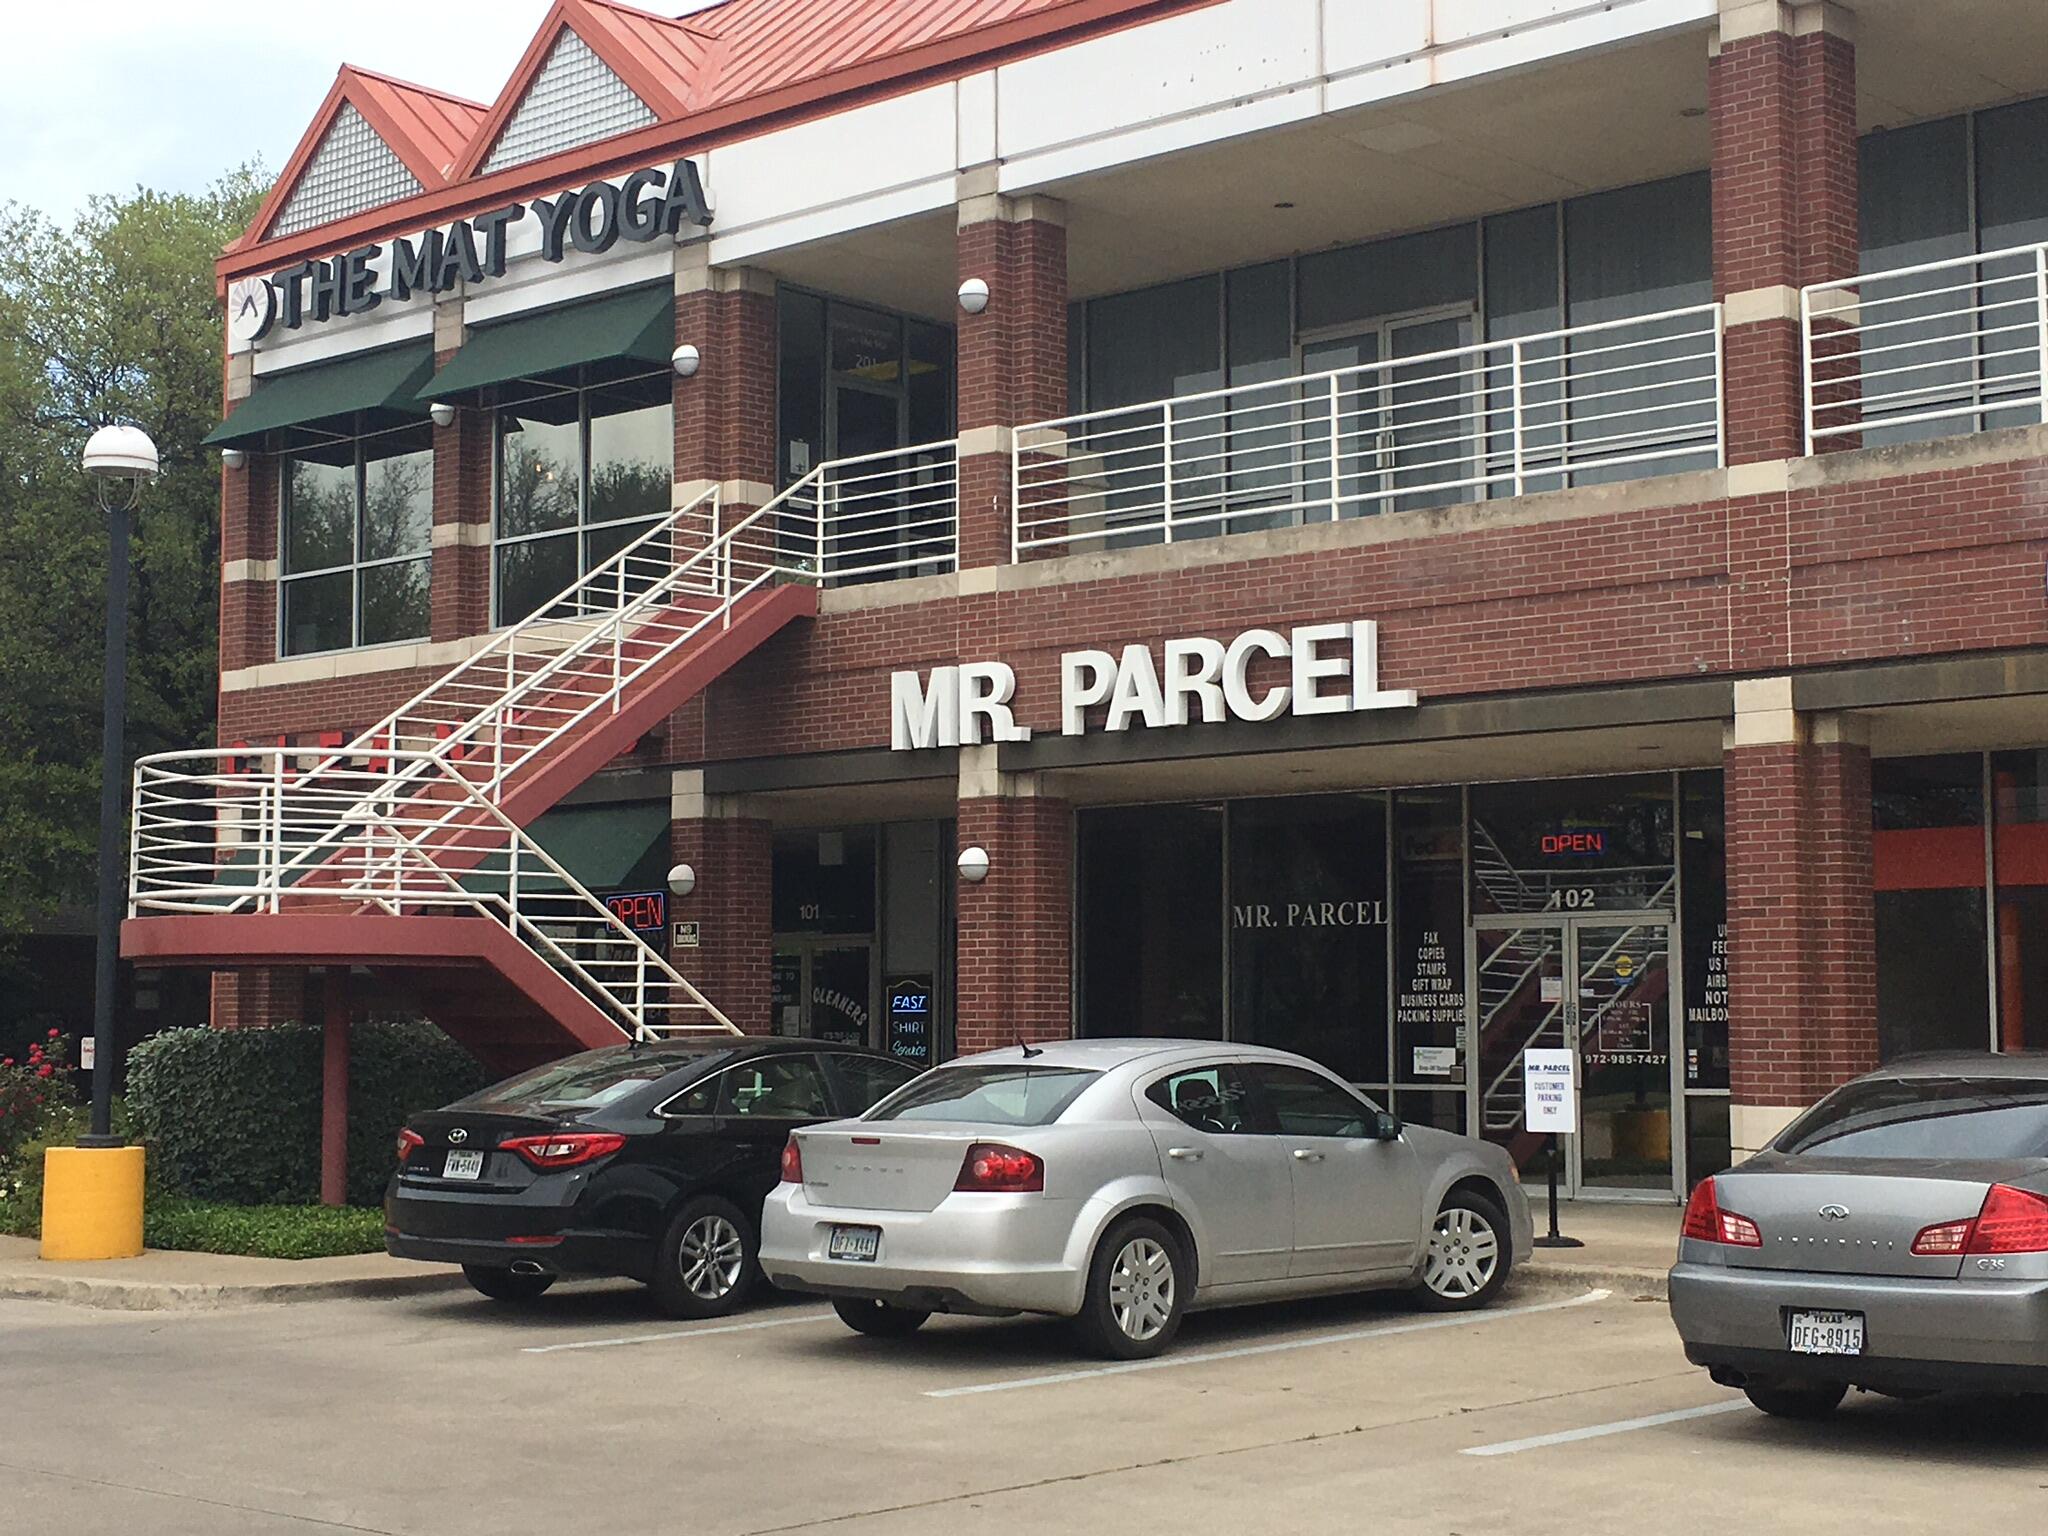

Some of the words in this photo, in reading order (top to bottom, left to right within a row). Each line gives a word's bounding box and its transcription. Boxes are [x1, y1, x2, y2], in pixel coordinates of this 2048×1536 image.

[271, 244, 382, 330] THE
[391, 203, 526, 301] MAT
[530, 158, 714, 264] YOGA
[1061, 619, 1418, 736] PARCEL
[1541, 832, 1602, 853] OPEN
[1551, 888, 1595, 909] 102
[608, 896, 661, 929] OPEN
[799, 904, 819, 920] 101
[1233, 904, 1277, 928] MR.
[1288, 900, 1389, 926] PARCEL
[1423, 931, 1439, 944] FAX
[1417, 947, 1445, 960] COPIES
[1417, 963, 1447, 976] STAMPS
[1412, 979, 1428, 991] GIFT
[1431, 978, 1452, 991] WRAP
[813, 987, 867, 1026] CLEANERS
[892, 995, 927, 1009] FAST
[1401, 994, 1438, 1007] BUSINESS
[1439, 993, 1464, 1006] CARDS
[1397, 1010, 1431, 1023] PACKING
[1543, 1064, 1570, 1072] PARCEL
[1534, 1082, 1565, 1090] CUSTOMER
[1537, 1093, 1562, 1102] PARKING
[1976, 1258, 2005, 1271] G35
